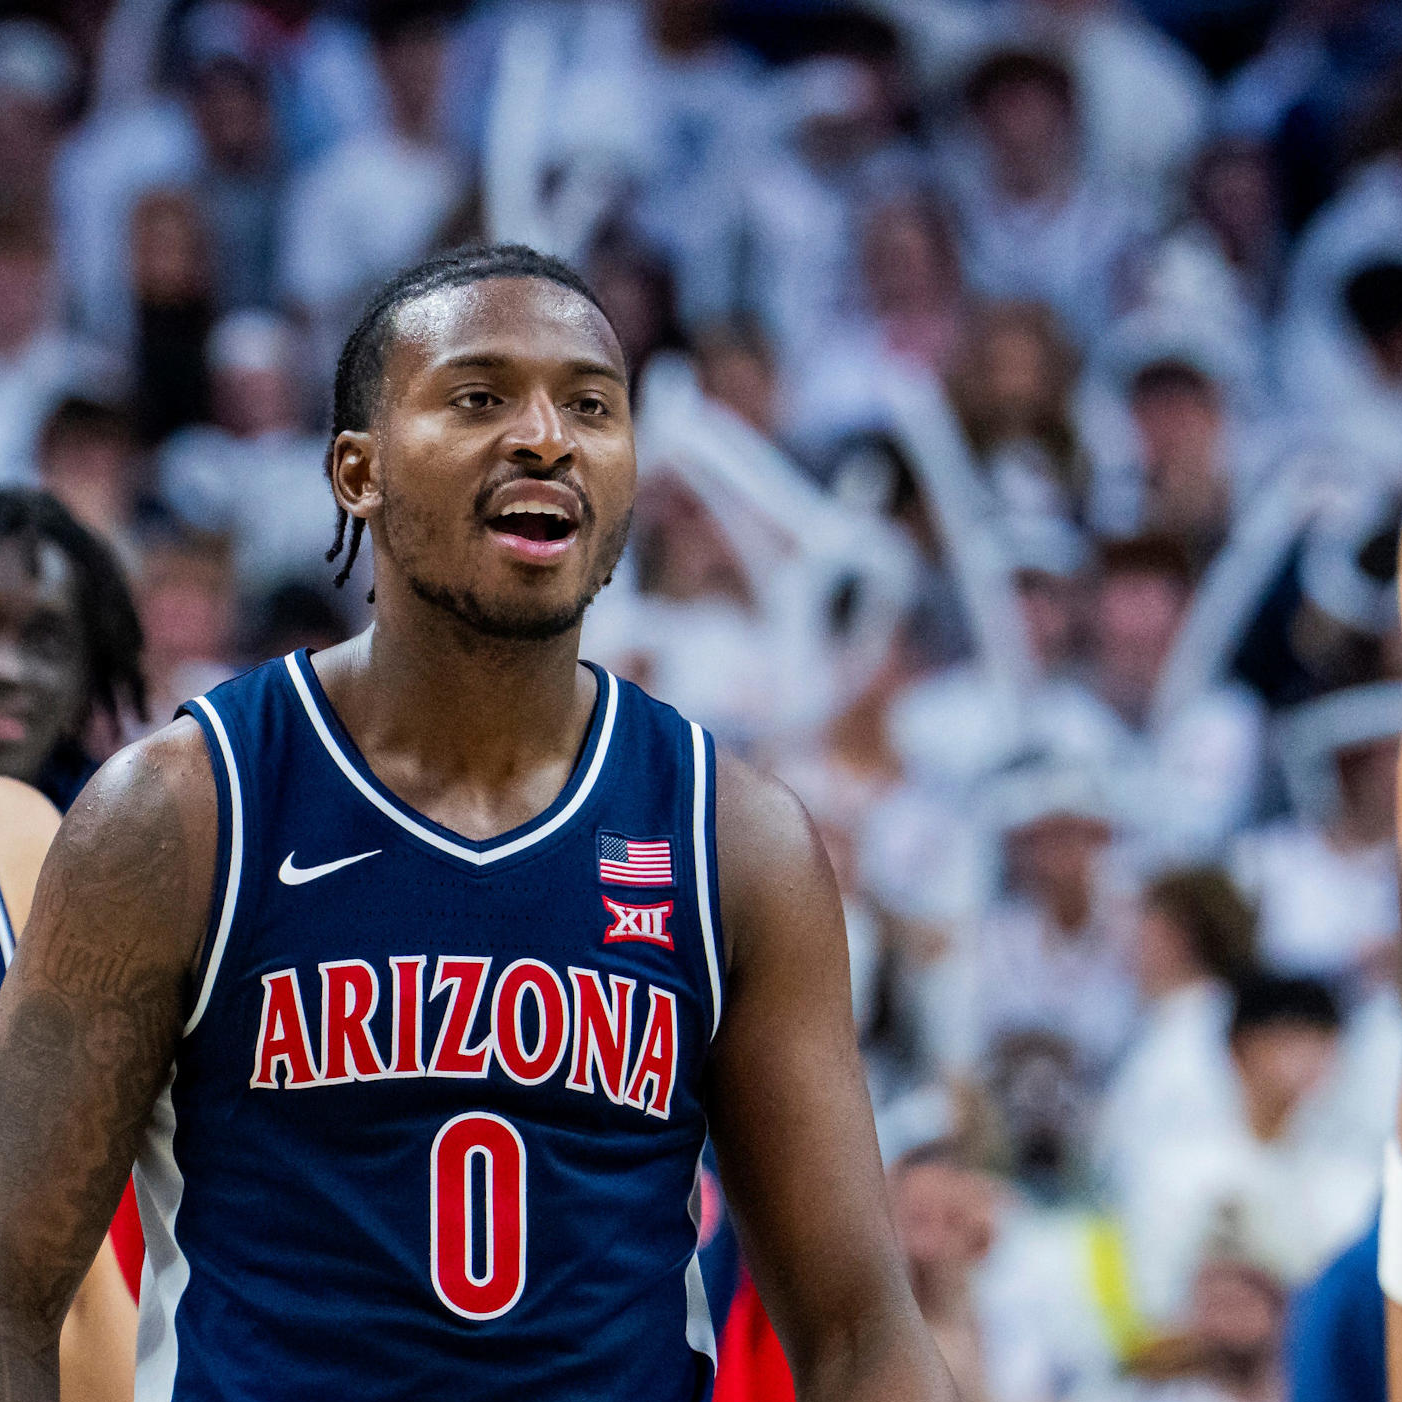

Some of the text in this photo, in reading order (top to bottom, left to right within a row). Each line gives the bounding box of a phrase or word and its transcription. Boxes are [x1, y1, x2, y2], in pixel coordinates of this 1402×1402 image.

[606, 900, 671, 943] XII
[250, 954, 678, 1120] ARIZONA
[430, 1111, 527, 1321] 0
